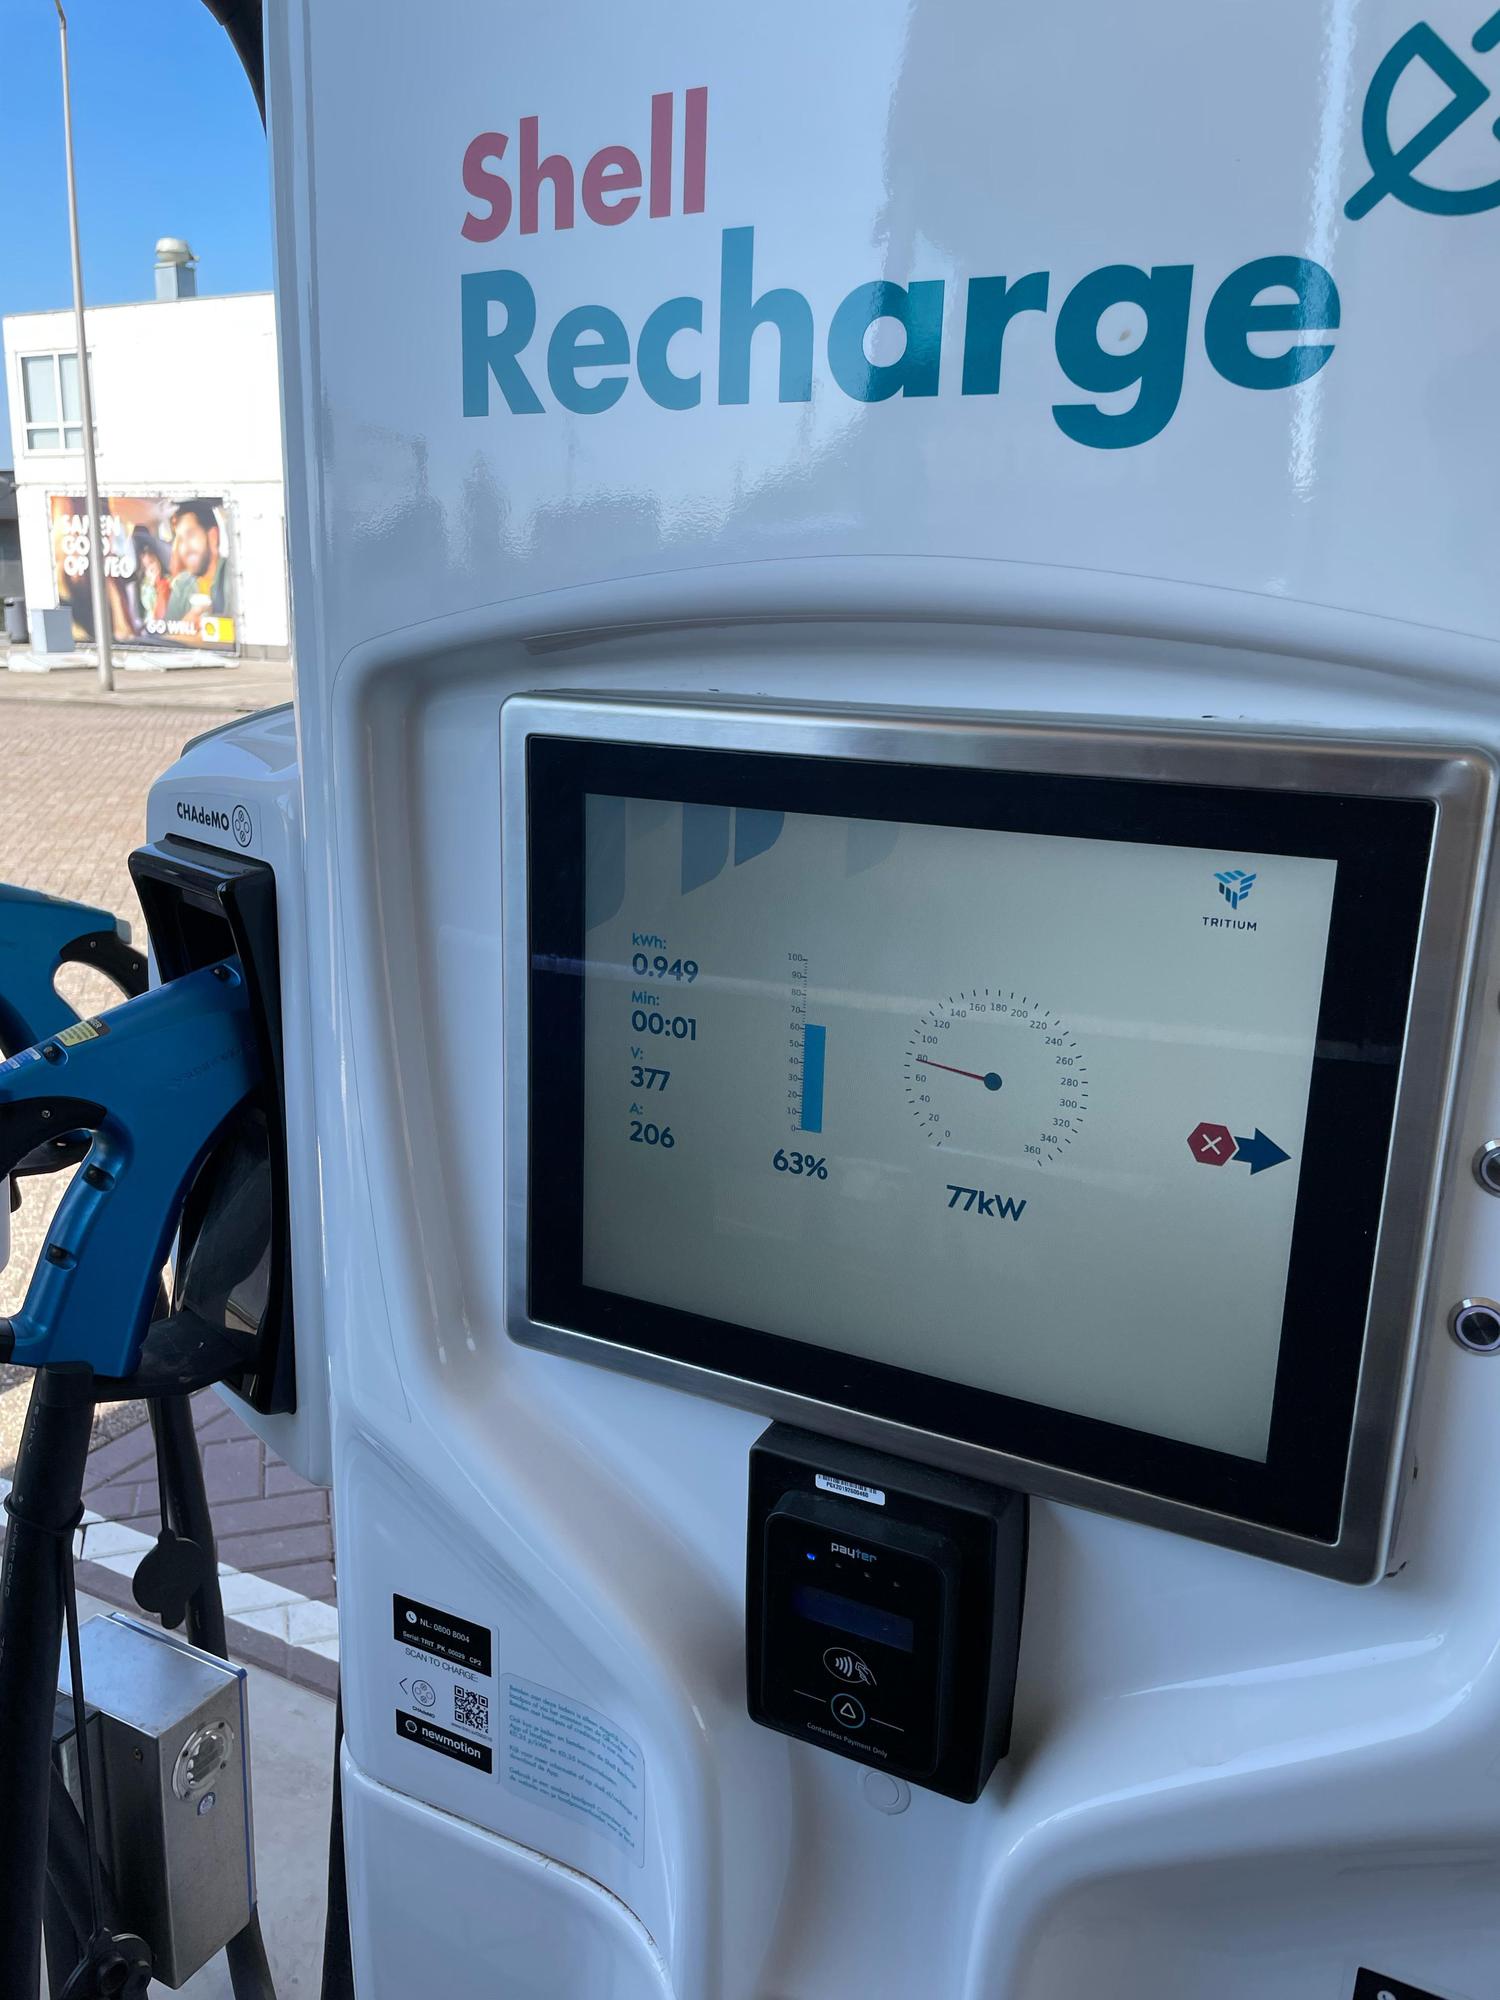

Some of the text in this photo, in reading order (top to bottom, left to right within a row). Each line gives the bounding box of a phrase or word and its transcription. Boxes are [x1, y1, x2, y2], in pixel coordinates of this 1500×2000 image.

[460, 86, 709, 243] Shell
[460, 225, 1342, 450] Recharge
[146, 619, 166, 634] GO
[177, 802, 229, 831] CHAdeMO
[1202, 916, 1258, 932] TRITIUM
[632, 933, 667, 950] kWh:
[788, 953, 803, 962] 100
[632, 953, 699, 983] 0.949
[792, 971, 802, 979] 90
[631, 991, 660, 1006] Min:
[791, 1006, 801, 1014] 70
[969, 1003, 986, 1012] 160
[990, 1003, 1007, 1012] 180
[950, 1008, 967, 1018] 140
[1010, 1009, 1028, 1019] 200
[631, 1009, 697, 1041] 00:01
[790, 1023, 800, 1031] 60
[934, 1020, 950, 1029] 120
[1029, 1020, 1047, 1030] 220
[789, 1040, 800, 1048] 50
[921, 1035, 938, 1045] 100
[1045, 1036, 1063, 1046] 240
[630, 1046, 644, 1060] V:
[788, 1057, 799, 1065] 40
[1056, 1056, 1074, 1066] 260
[630, 1065, 671, 1091] 377
[788, 1074, 798, 1082] 30
[915, 1074, 927, 1083] 60
[1060, 1077, 1078, 1087] 280
[787, 1090, 798, 1099] 20
[919, 1094, 931, 1103] 40
[629, 1102, 644, 1115] A:
[1059, 1099, 1078, 1109] 300
[787, 1107, 797, 1115] 10
[928, 1113, 940, 1122] 20
[1052, 1118, 1070, 1128] 320
[629, 1120, 675, 1148] 206
[945, 1130, 951, 1138] 0
[1040, 1133, 1058, 1144] 340
[1023, 1145, 1041, 1155] 360
[773, 1149, 828, 1180] 63%
[946, 1184, 1027, 1222] 77kW
[830, 1541, 877, 1563] payter
[405, 1647, 427, 1662] SCAN
[430, 1657, 441, 1667] TO
[421, 1727, 481, 1758] newmotion
[807, 1722, 888, 1758] Contactless Payment Only
